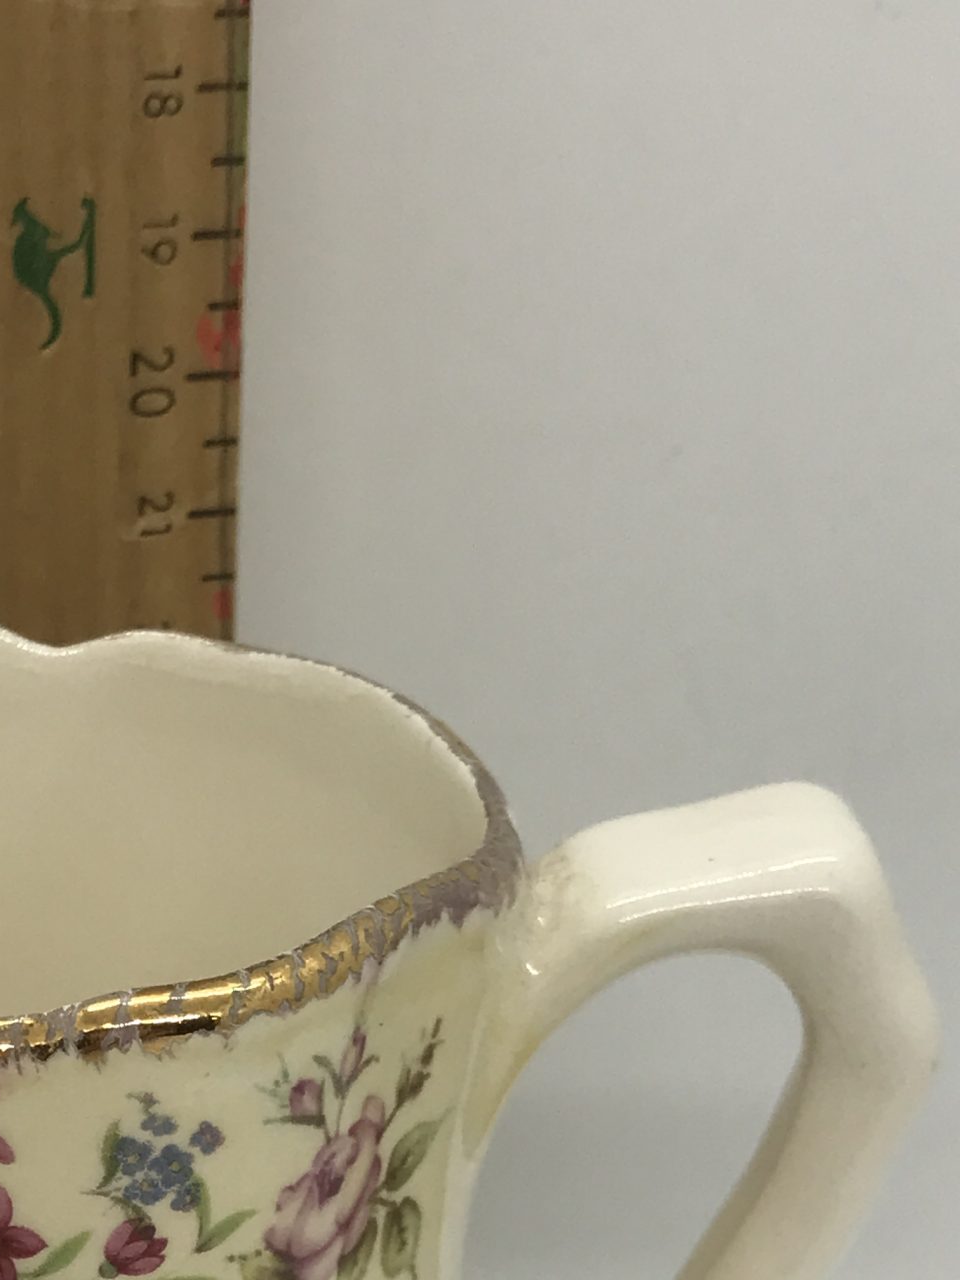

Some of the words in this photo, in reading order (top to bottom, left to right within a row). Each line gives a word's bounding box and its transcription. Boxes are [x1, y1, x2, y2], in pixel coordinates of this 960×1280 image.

[142, 64, 183, 119] 18
[141, 213, 179, 266] 19
[128, 346, 176, 419] 20
[138, 491, 175, 538] 21
